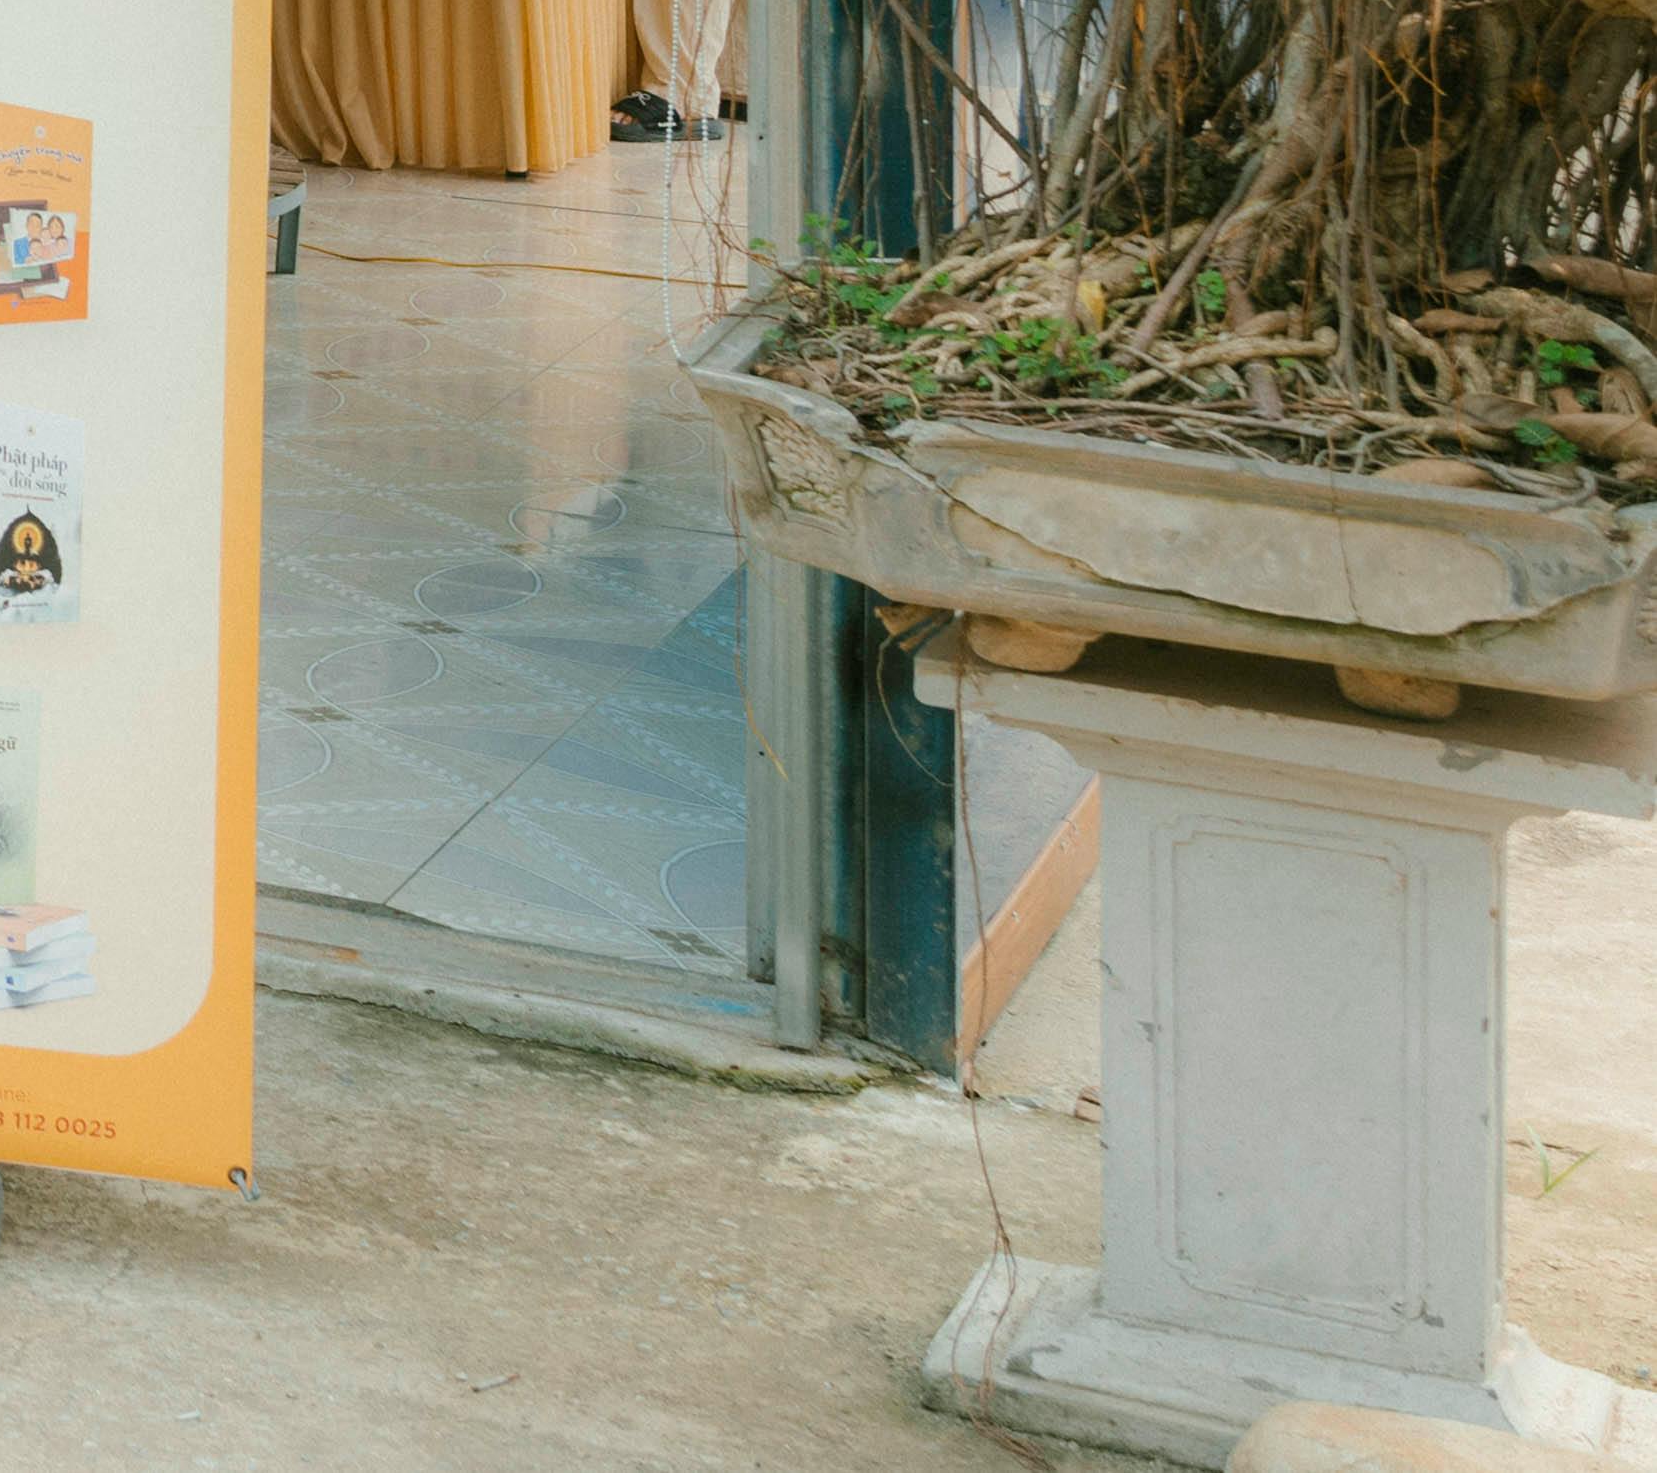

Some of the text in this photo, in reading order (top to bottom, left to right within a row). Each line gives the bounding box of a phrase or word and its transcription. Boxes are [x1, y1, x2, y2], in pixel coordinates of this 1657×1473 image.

[31, 451, 68, 477] pháp
[13, 1111, 47, 1132] 112
[54, 1116, 117, 1140] 0025
